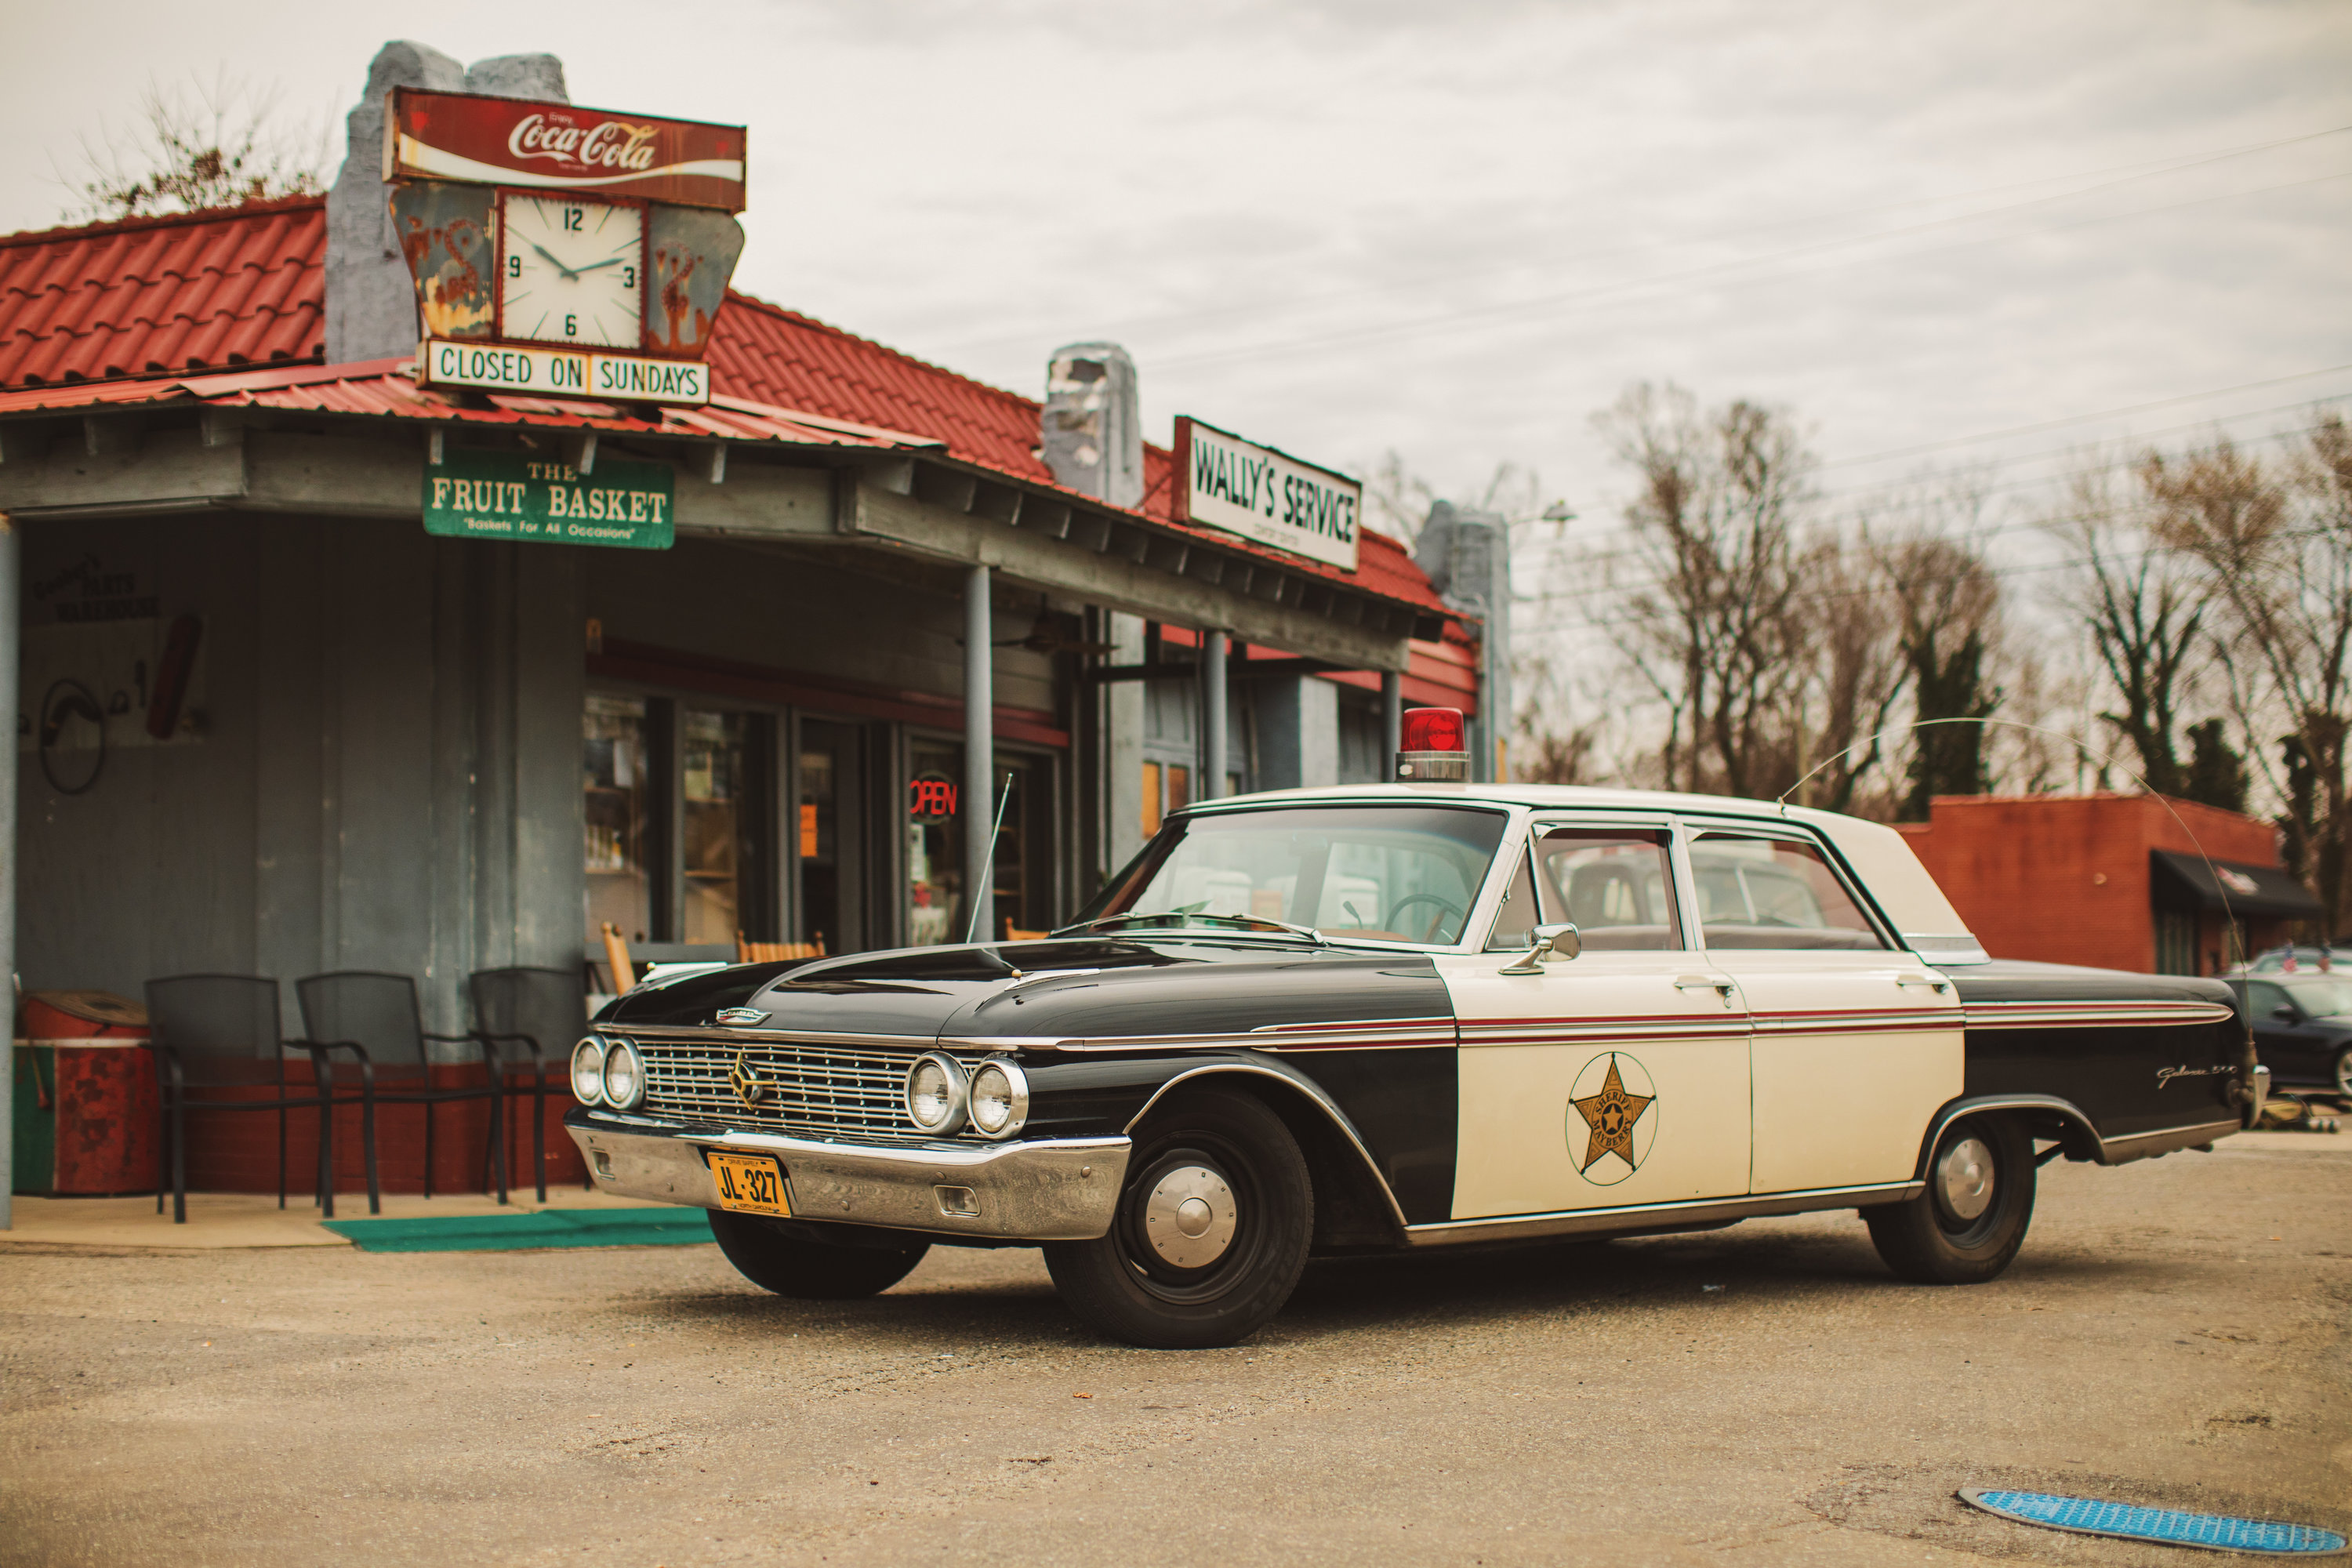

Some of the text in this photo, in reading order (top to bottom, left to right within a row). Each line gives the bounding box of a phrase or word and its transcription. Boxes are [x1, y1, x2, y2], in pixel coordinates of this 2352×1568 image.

[508, 113, 659, 169] Coca-Cola
[564, 208, 583, 231] 12
[510, 256, 521, 278] 9
[623, 267, 634, 289] 3
[564, 314, 576, 336] 6
[440, 347, 699, 397] CLOSED ON SUNDAYS
[527, 463, 577, 482] THE
[432, 477, 666, 524] FRUIT BASKET
[1194, 437, 1355, 543] WALLY'S SERVICE
[519, 521, 539, 533] For
[546, 522, 561, 535] All
[909, 780, 958, 815] OPEN
[1595, 1091, 1631, 1114] SHERIFF
[1593, 1117, 1632, 1147] MAYBERRY
